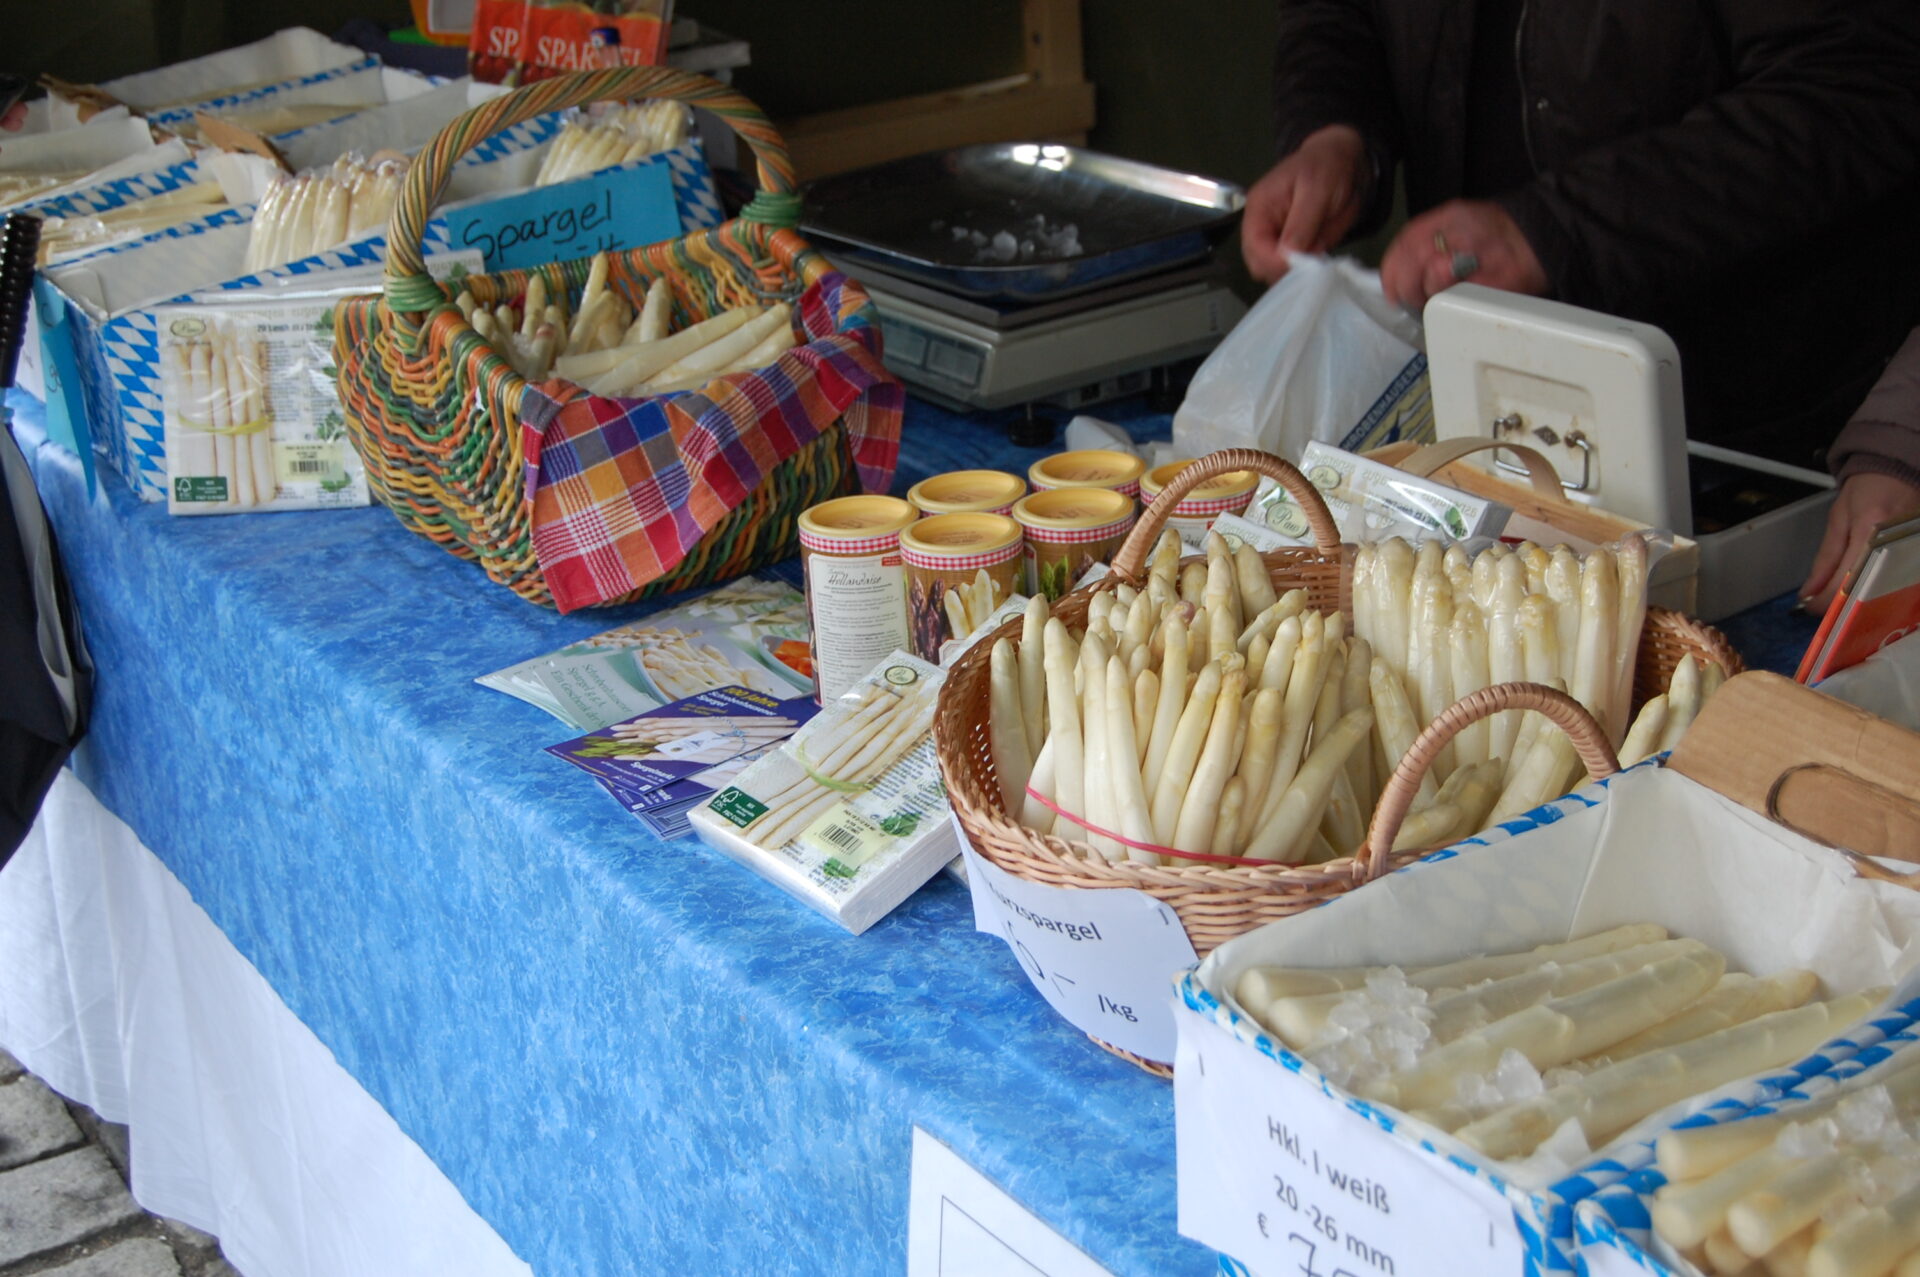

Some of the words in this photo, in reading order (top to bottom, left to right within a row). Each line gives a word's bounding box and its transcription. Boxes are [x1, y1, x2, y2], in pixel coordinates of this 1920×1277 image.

[488, 25, 520, 58] SP
[463, 189, 612, 263] Spargel
[1267, 1114, 1307, 1166] Hkl.
[1326, 1162, 1391, 1215] weiß
[1346, 1230, 1396, 1277] mm
